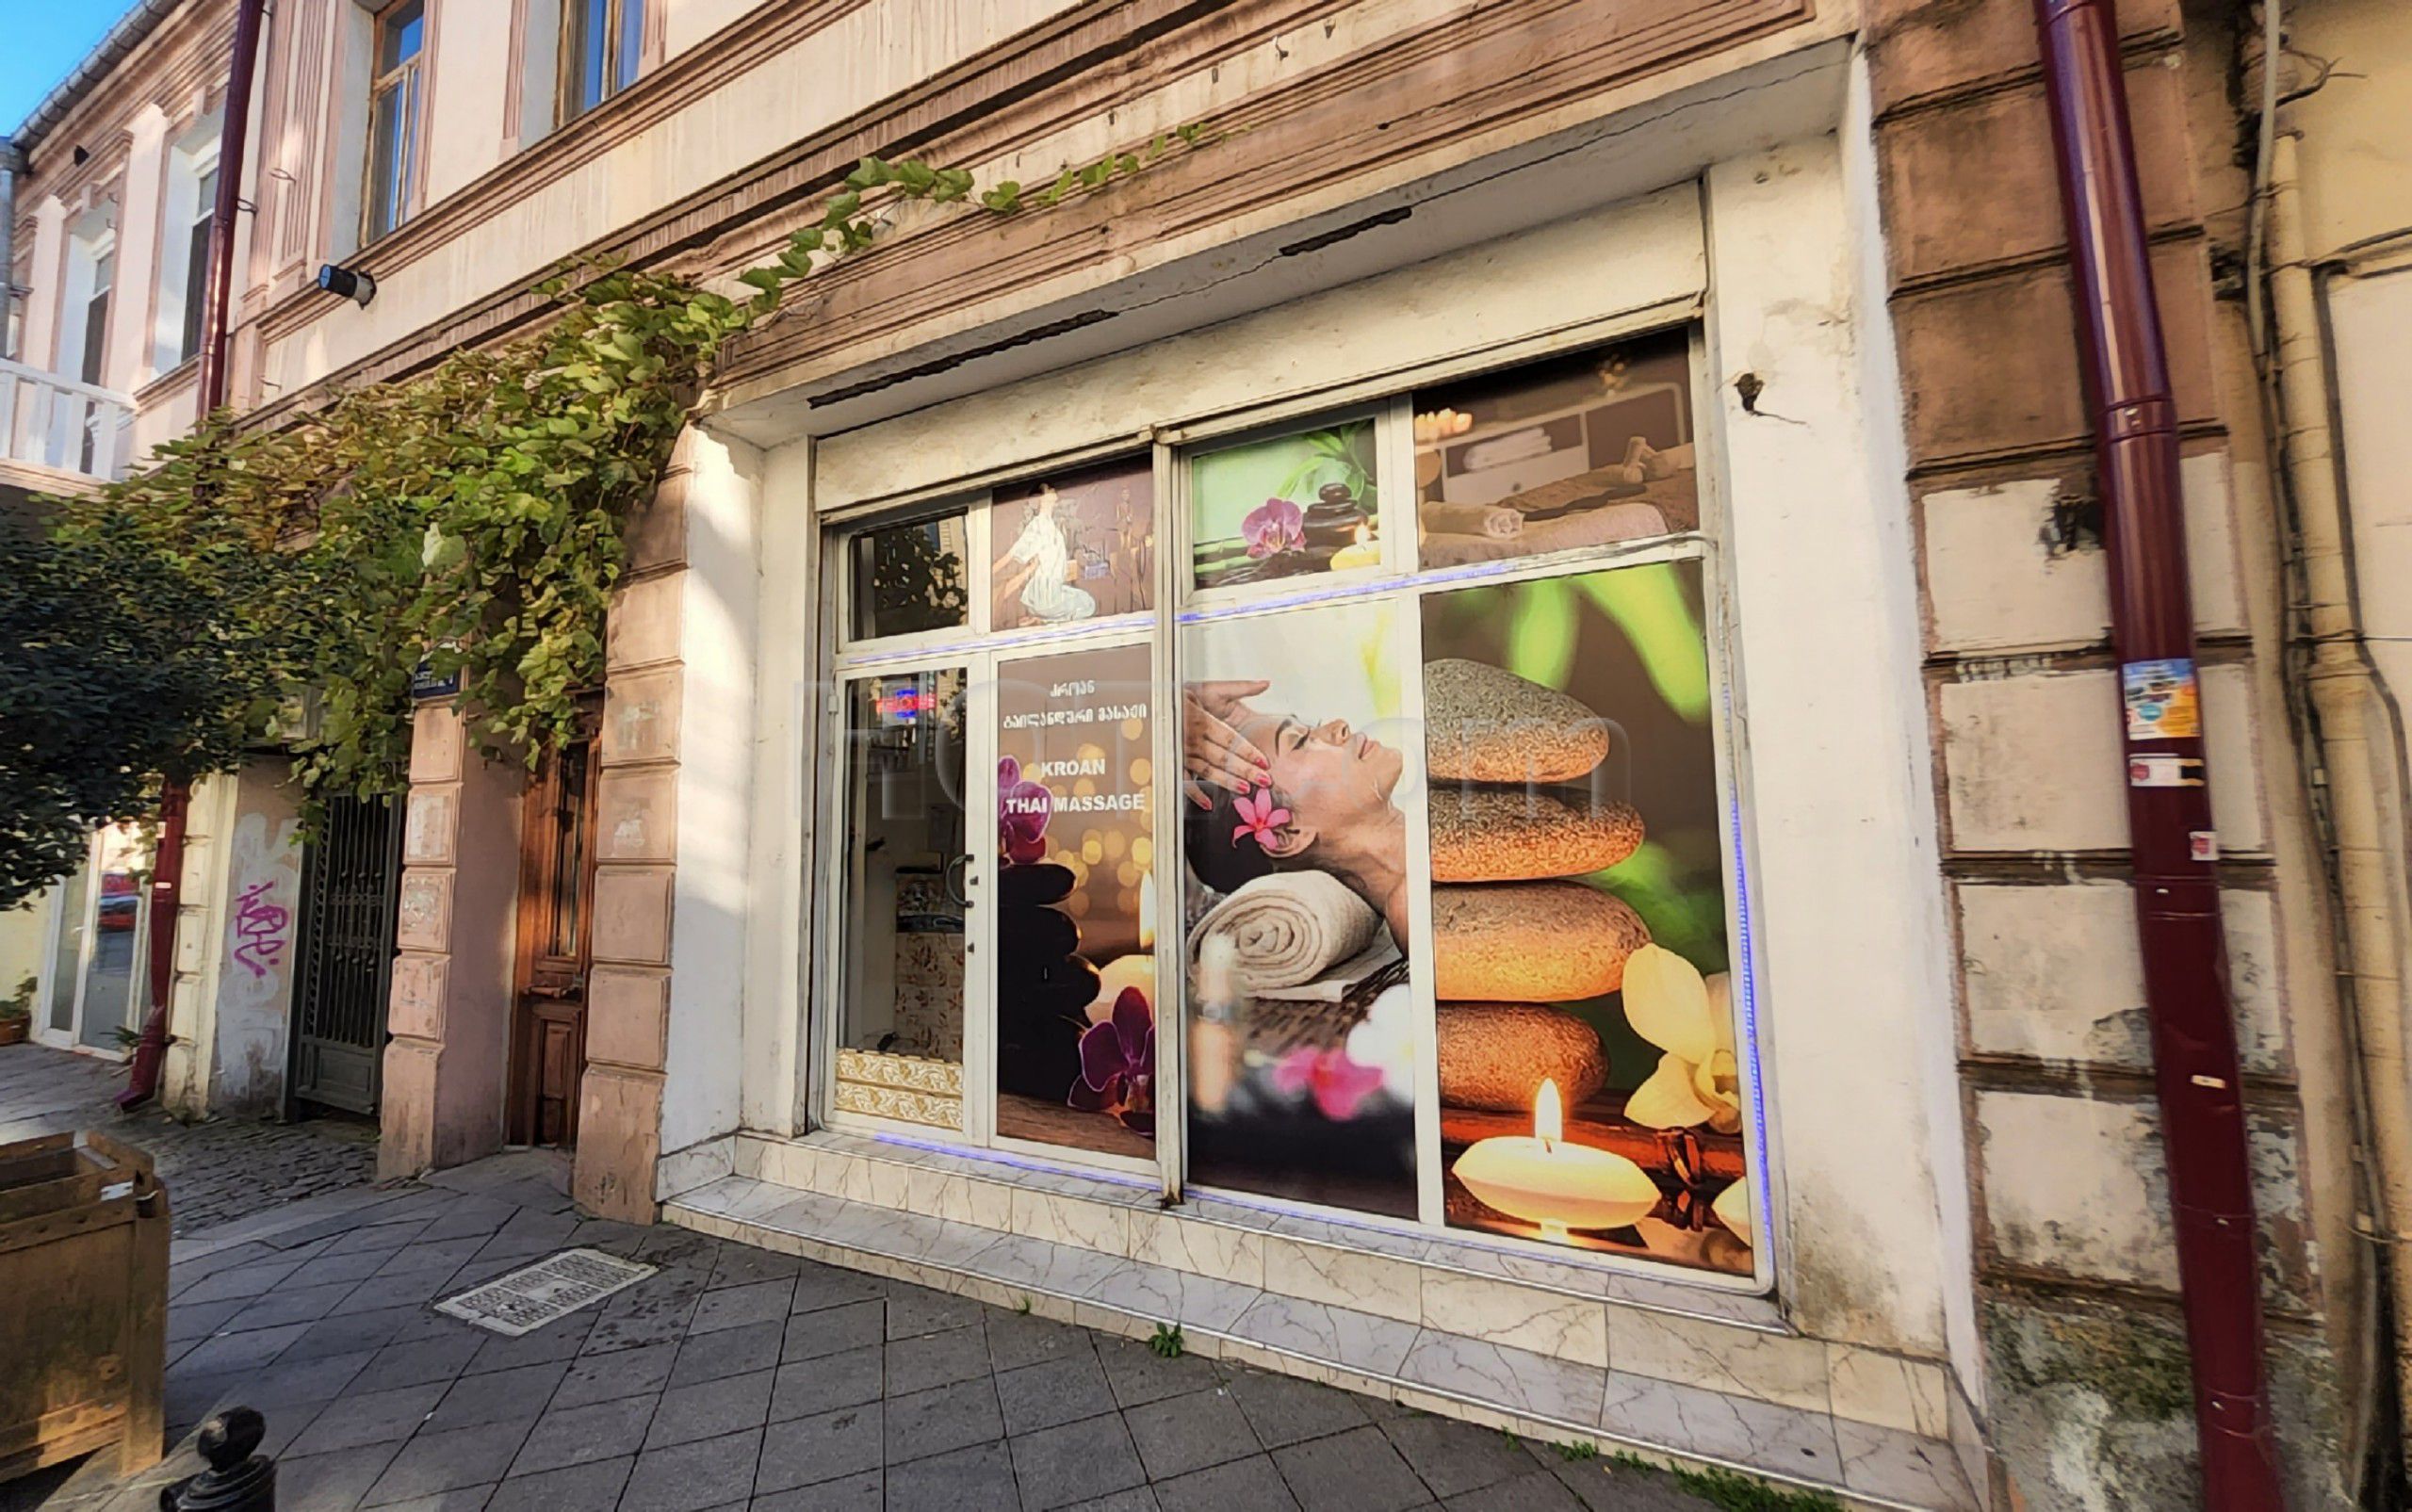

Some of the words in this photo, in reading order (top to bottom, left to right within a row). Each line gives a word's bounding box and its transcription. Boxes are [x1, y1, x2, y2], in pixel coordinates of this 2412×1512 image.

[1041, 758, 1105, 776] KROAN
[1006, 796, 1048, 814] THAI
[1053, 793, 1146, 813] MASSAGE
